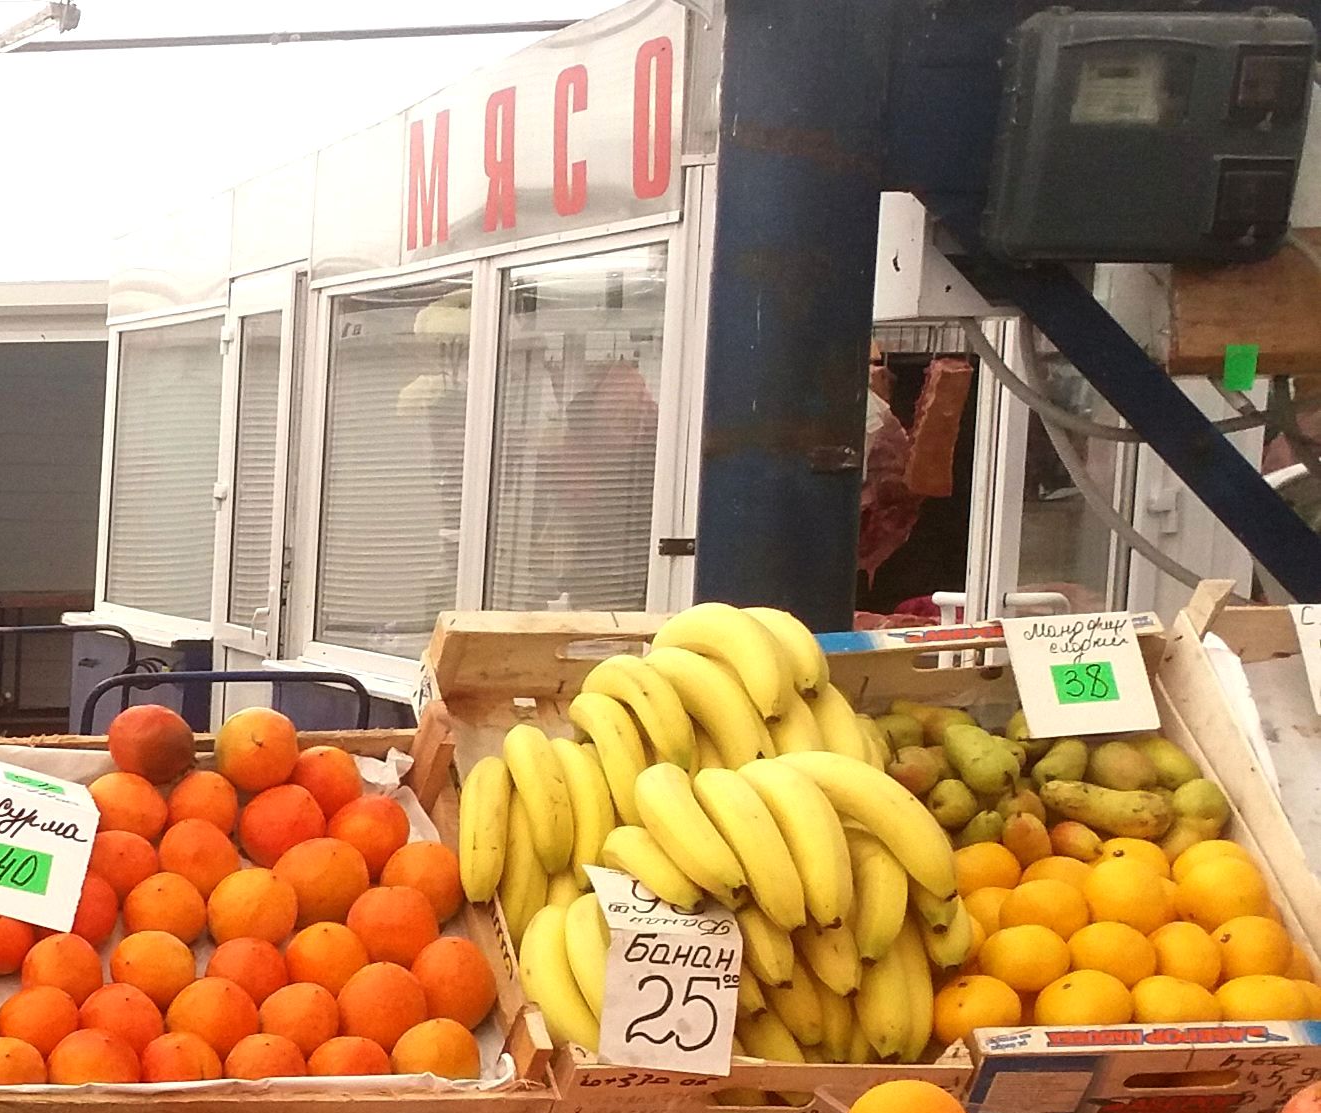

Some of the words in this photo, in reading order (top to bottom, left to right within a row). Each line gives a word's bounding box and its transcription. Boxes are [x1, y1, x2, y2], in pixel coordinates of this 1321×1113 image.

[407, 36, 673, 251] МЯСО
[1065, 663, 1109, 698] 38
[624, 933, 736, 972] Банан
[625, 974, 720, 1052] 25
